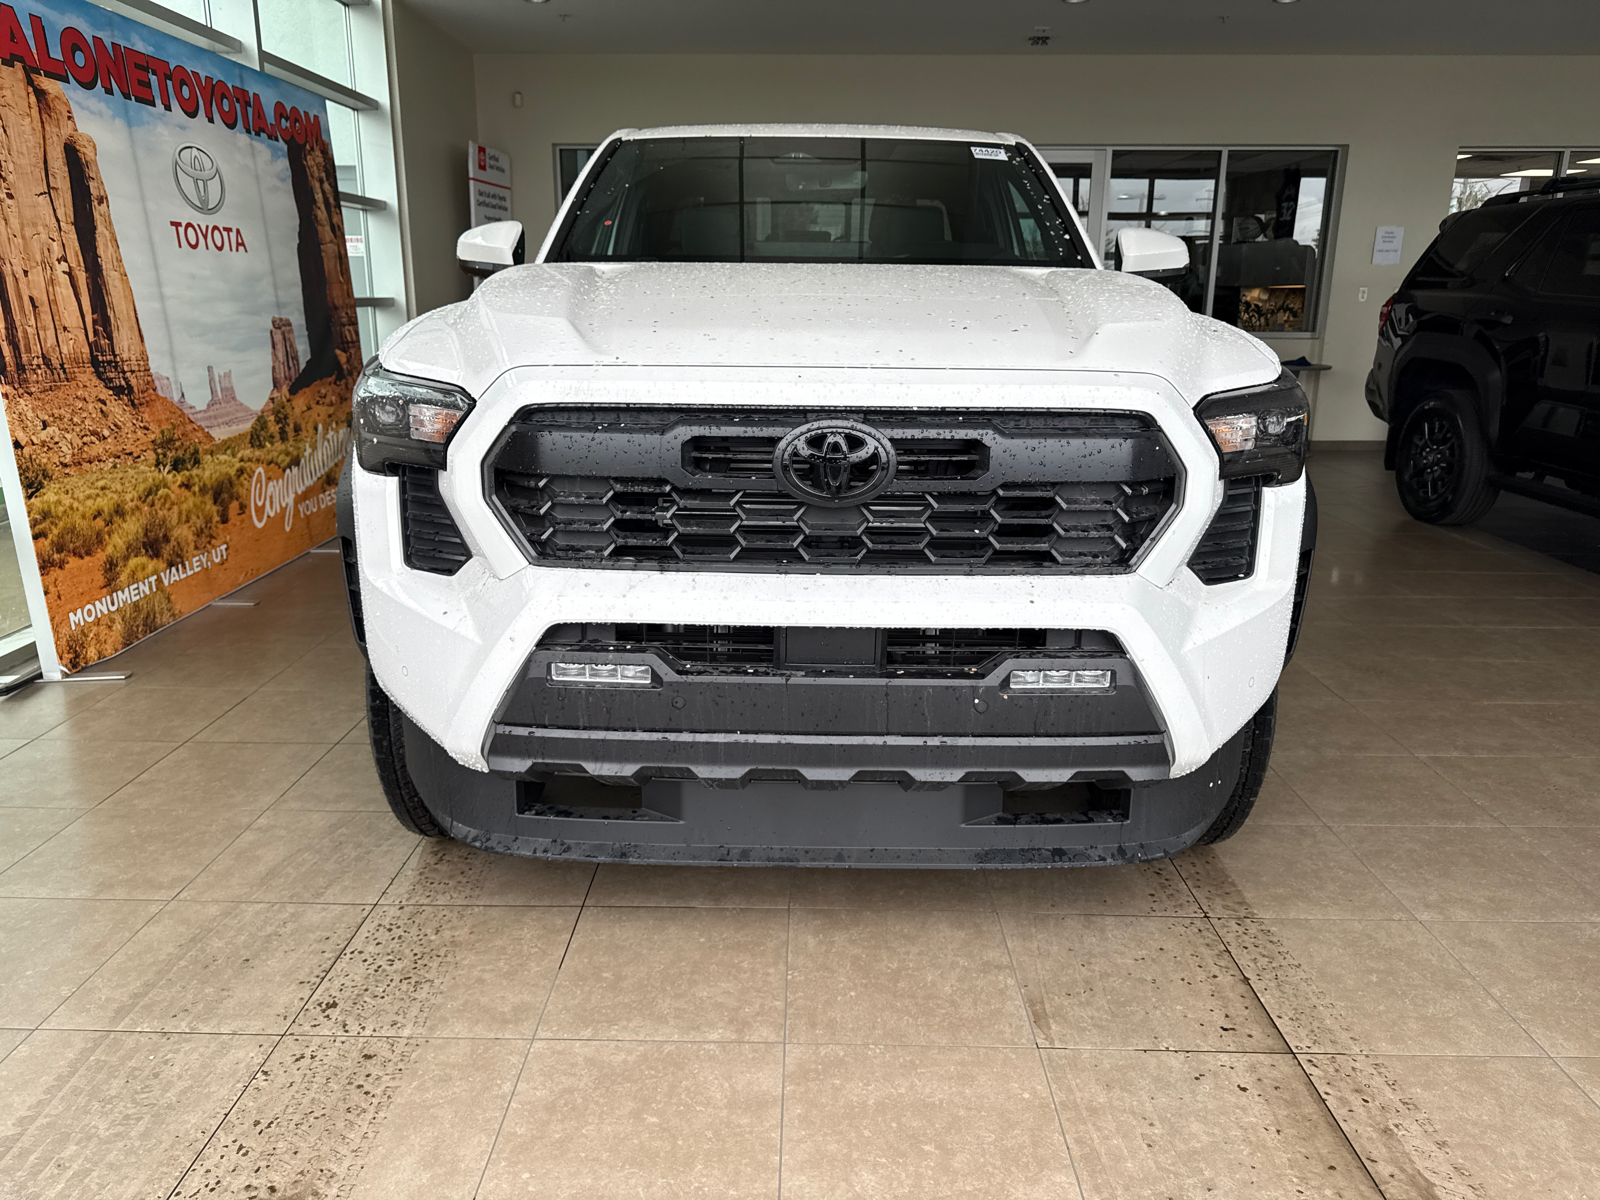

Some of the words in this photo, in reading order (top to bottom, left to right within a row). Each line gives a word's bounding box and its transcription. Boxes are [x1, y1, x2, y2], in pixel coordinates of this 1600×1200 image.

[169, 220, 248, 253] TOYOTA
[298, 496, 318, 518] YOU
[318, 488, 337, 509] DES
[68, 574, 158, 631] MONUMENT
[160, 551, 211, 587] VALLEY,
[212, 543, 228, 563] UT
